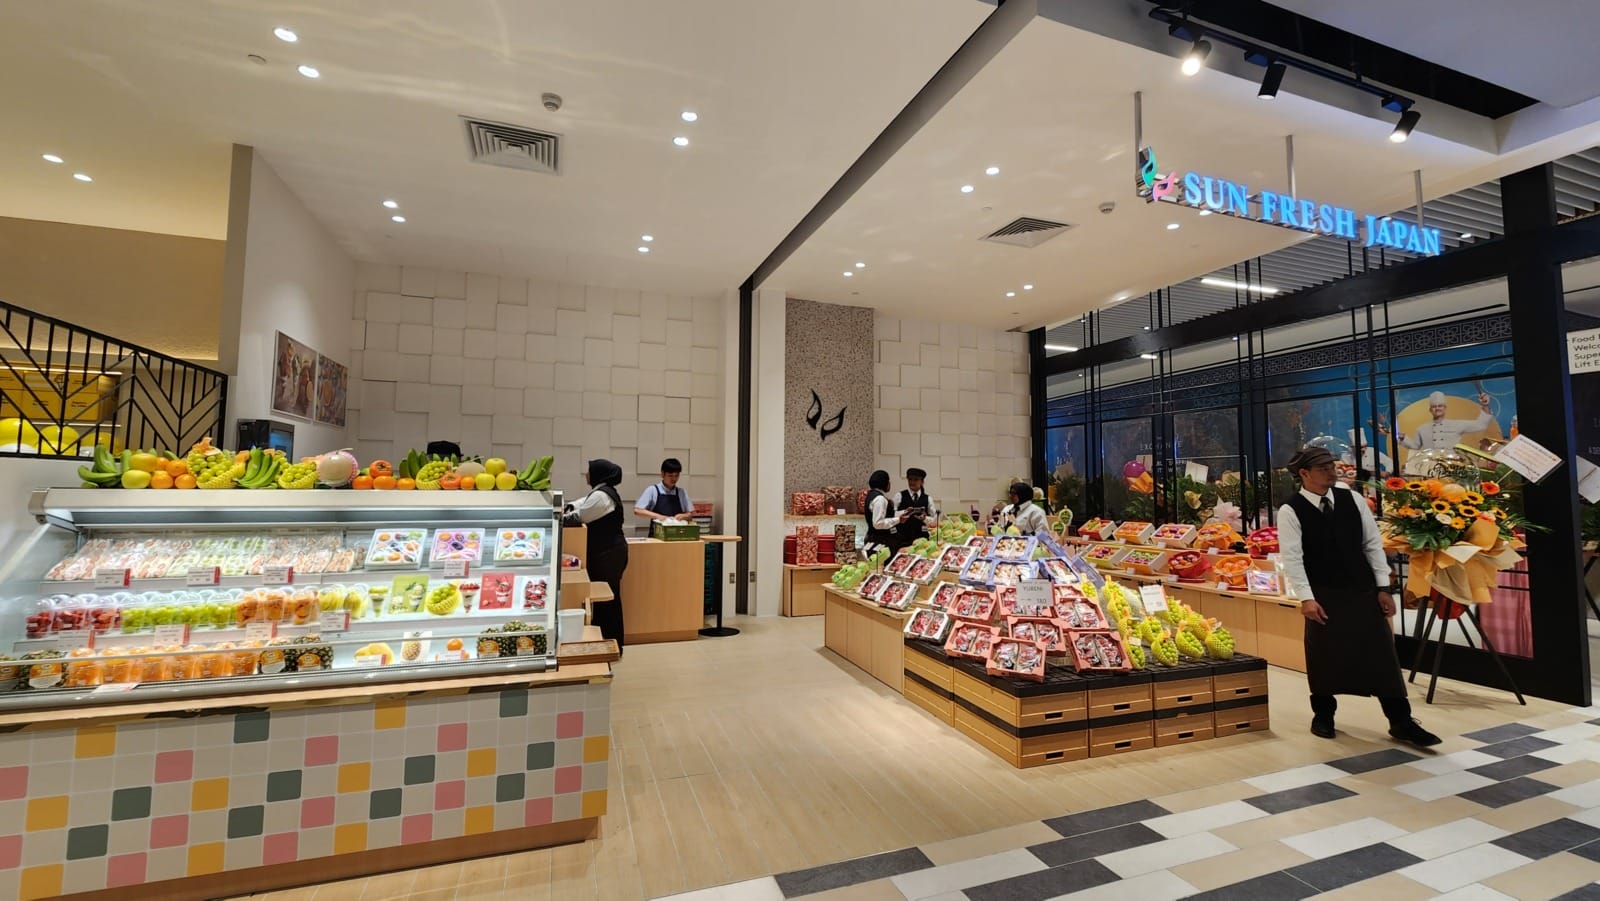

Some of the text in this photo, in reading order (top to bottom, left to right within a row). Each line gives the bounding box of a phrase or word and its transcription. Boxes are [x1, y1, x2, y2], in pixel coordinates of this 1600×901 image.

[1184, 172, 1440, 256] SUN FRESH JAPAN
[1572, 335, 1595, 343] Food
[1574, 352, 1600, 360] Supe
